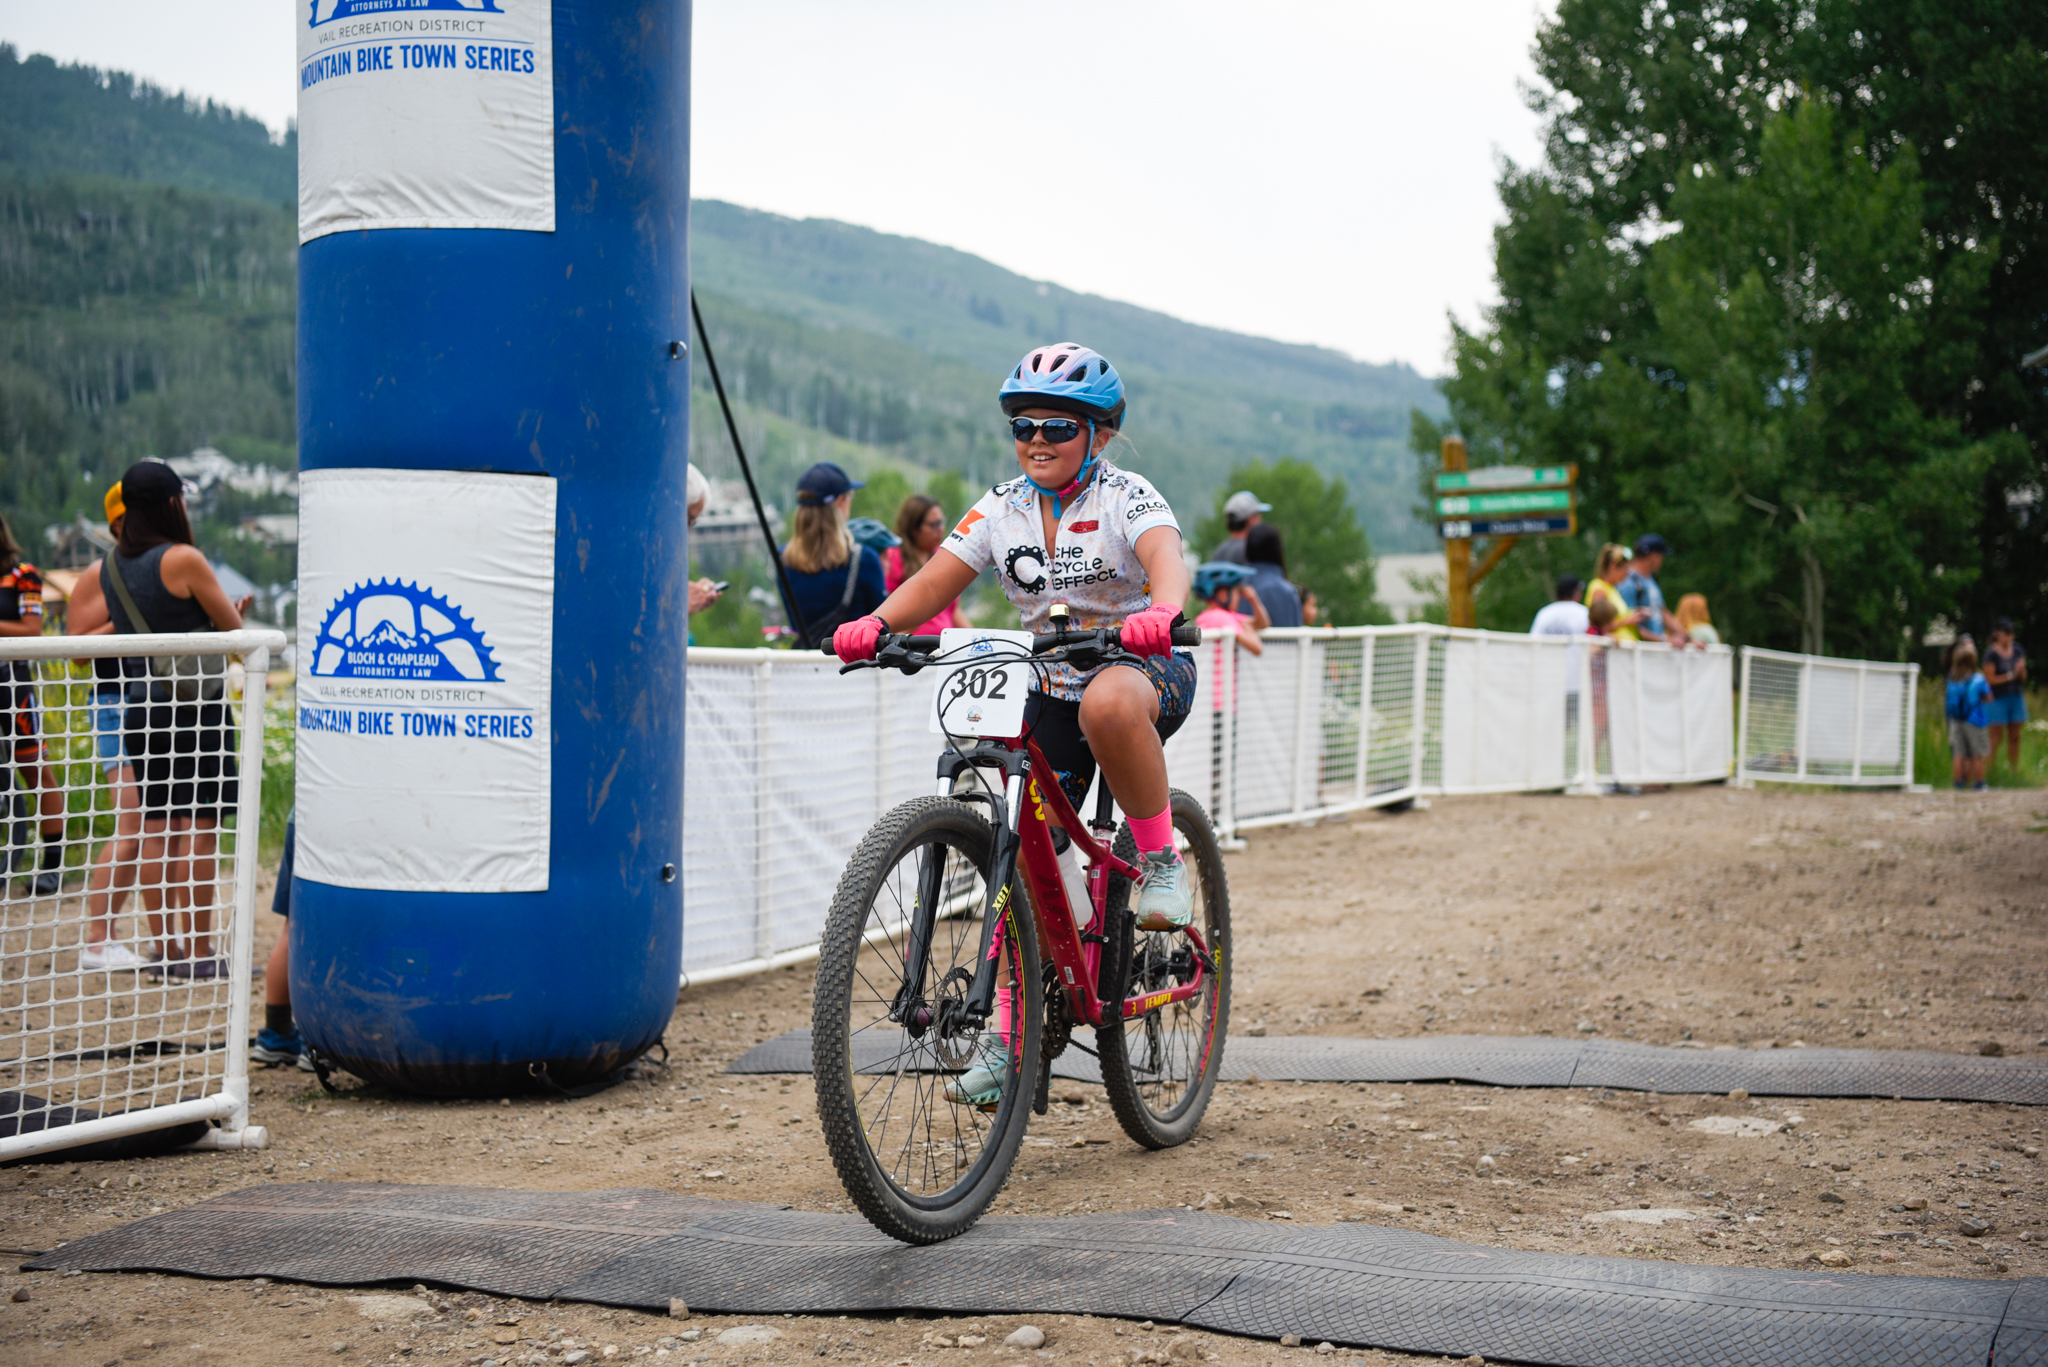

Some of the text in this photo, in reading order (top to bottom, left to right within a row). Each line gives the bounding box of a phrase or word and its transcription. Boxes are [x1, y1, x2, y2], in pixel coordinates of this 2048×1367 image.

[351, 0, 393, 13] ATTORNEYS
[397, 0, 406, 8] AT
[318, 20, 486, 44] VAIL RECREATION DISTRICT
[301, 45, 534, 91] MOUNTAIN BIKE TOWN SERIES
[348, 651, 439, 667] BLOCH & CHAPLEAU
[353, 666, 431, 678] ATTORNEYS AT LAW
[950, 668, 1008, 699] 302
[319, 686, 486, 702] VAIL RECREATION DISTRICT
[300, 706, 533, 738] MOUNTAIN BIKE TOWN SERIES
[1145, 992, 1172, 1010] TEMPT
